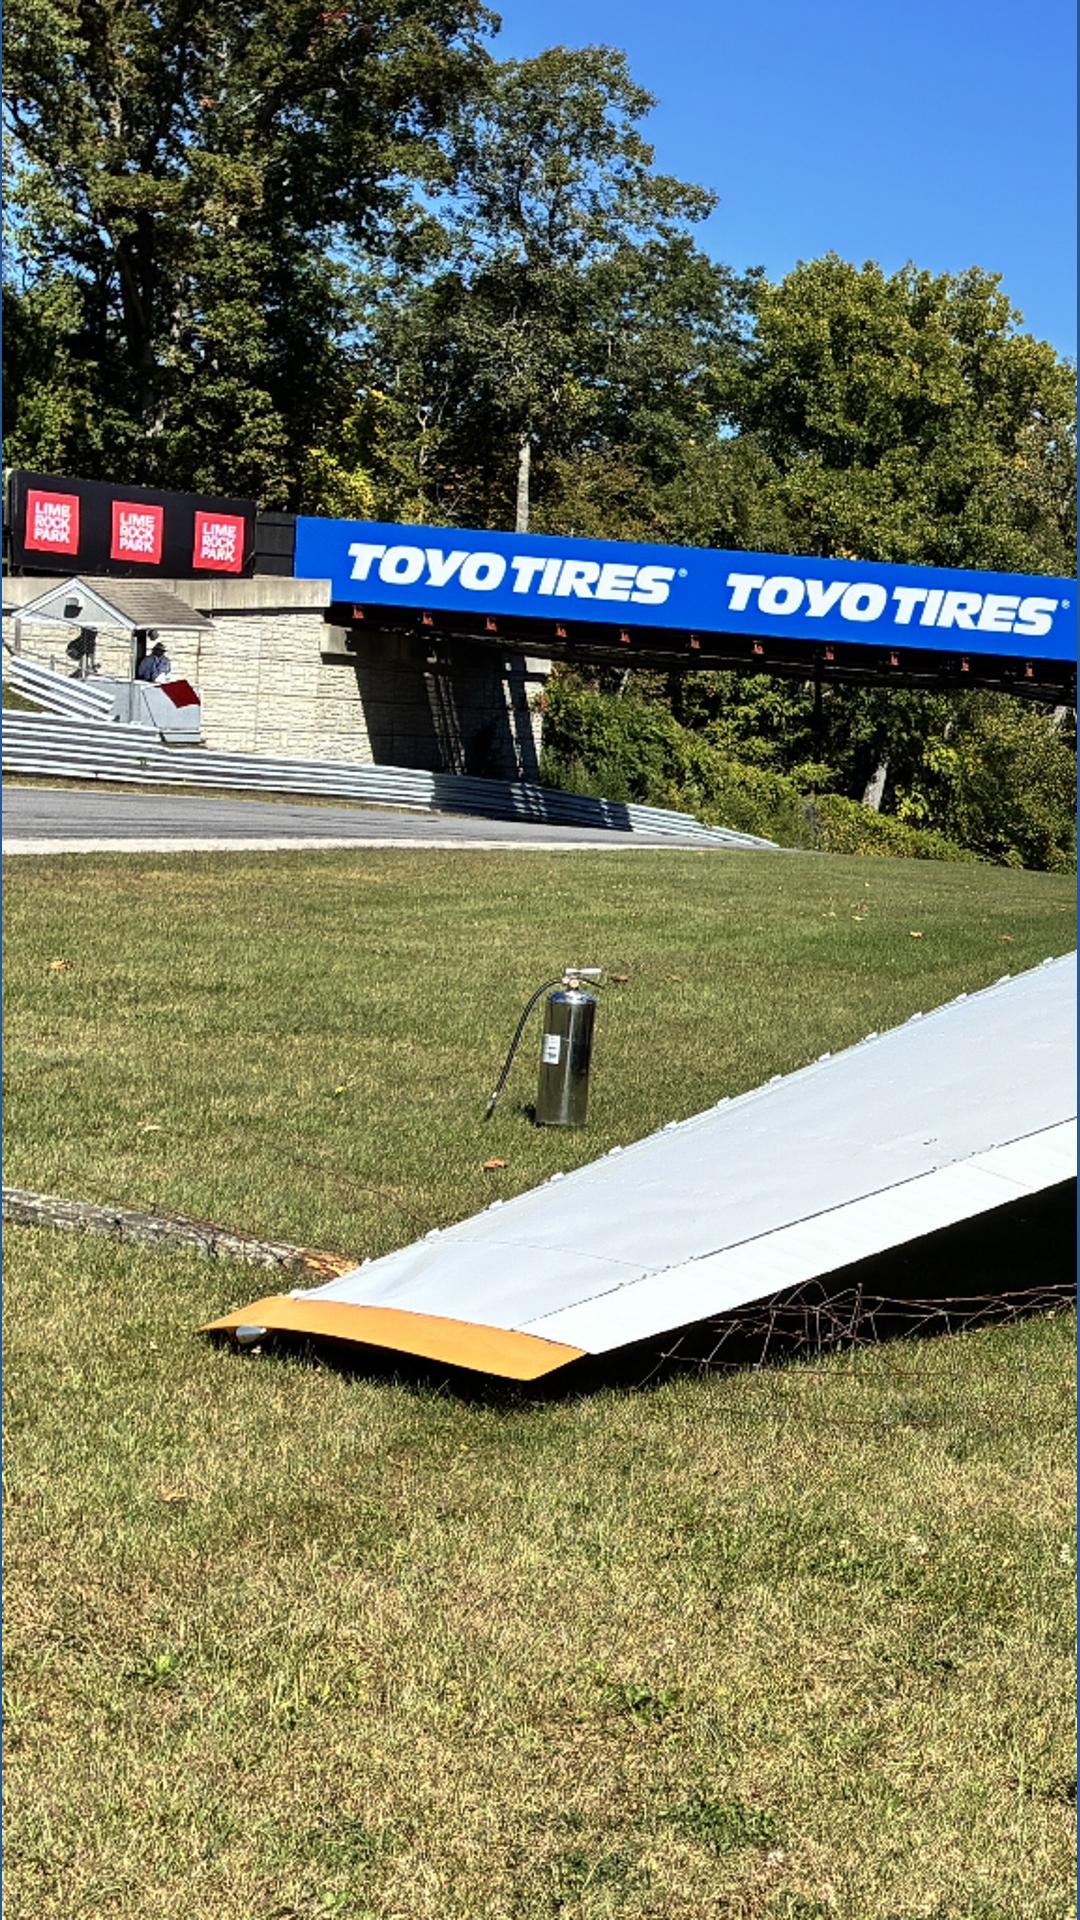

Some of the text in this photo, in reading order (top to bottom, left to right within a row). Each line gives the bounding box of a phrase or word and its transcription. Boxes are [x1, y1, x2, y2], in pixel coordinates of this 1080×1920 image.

[35, 501, 71, 518] LIME
[35, 514, 70, 531] ROCK
[120, 511, 155, 527] LIME
[34, 528, 70, 544] PARK
[120, 524, 154, 541] ROCK
[203, 522, 237, 538] LIME
[119, 537, 153, 553] PARK
[202, 534, 236, 551] ROCK
[201, 546, 235, 562] PARK
[348, 543, 506, 591] TOYO
[726, 573, 887, 622] TOYO
